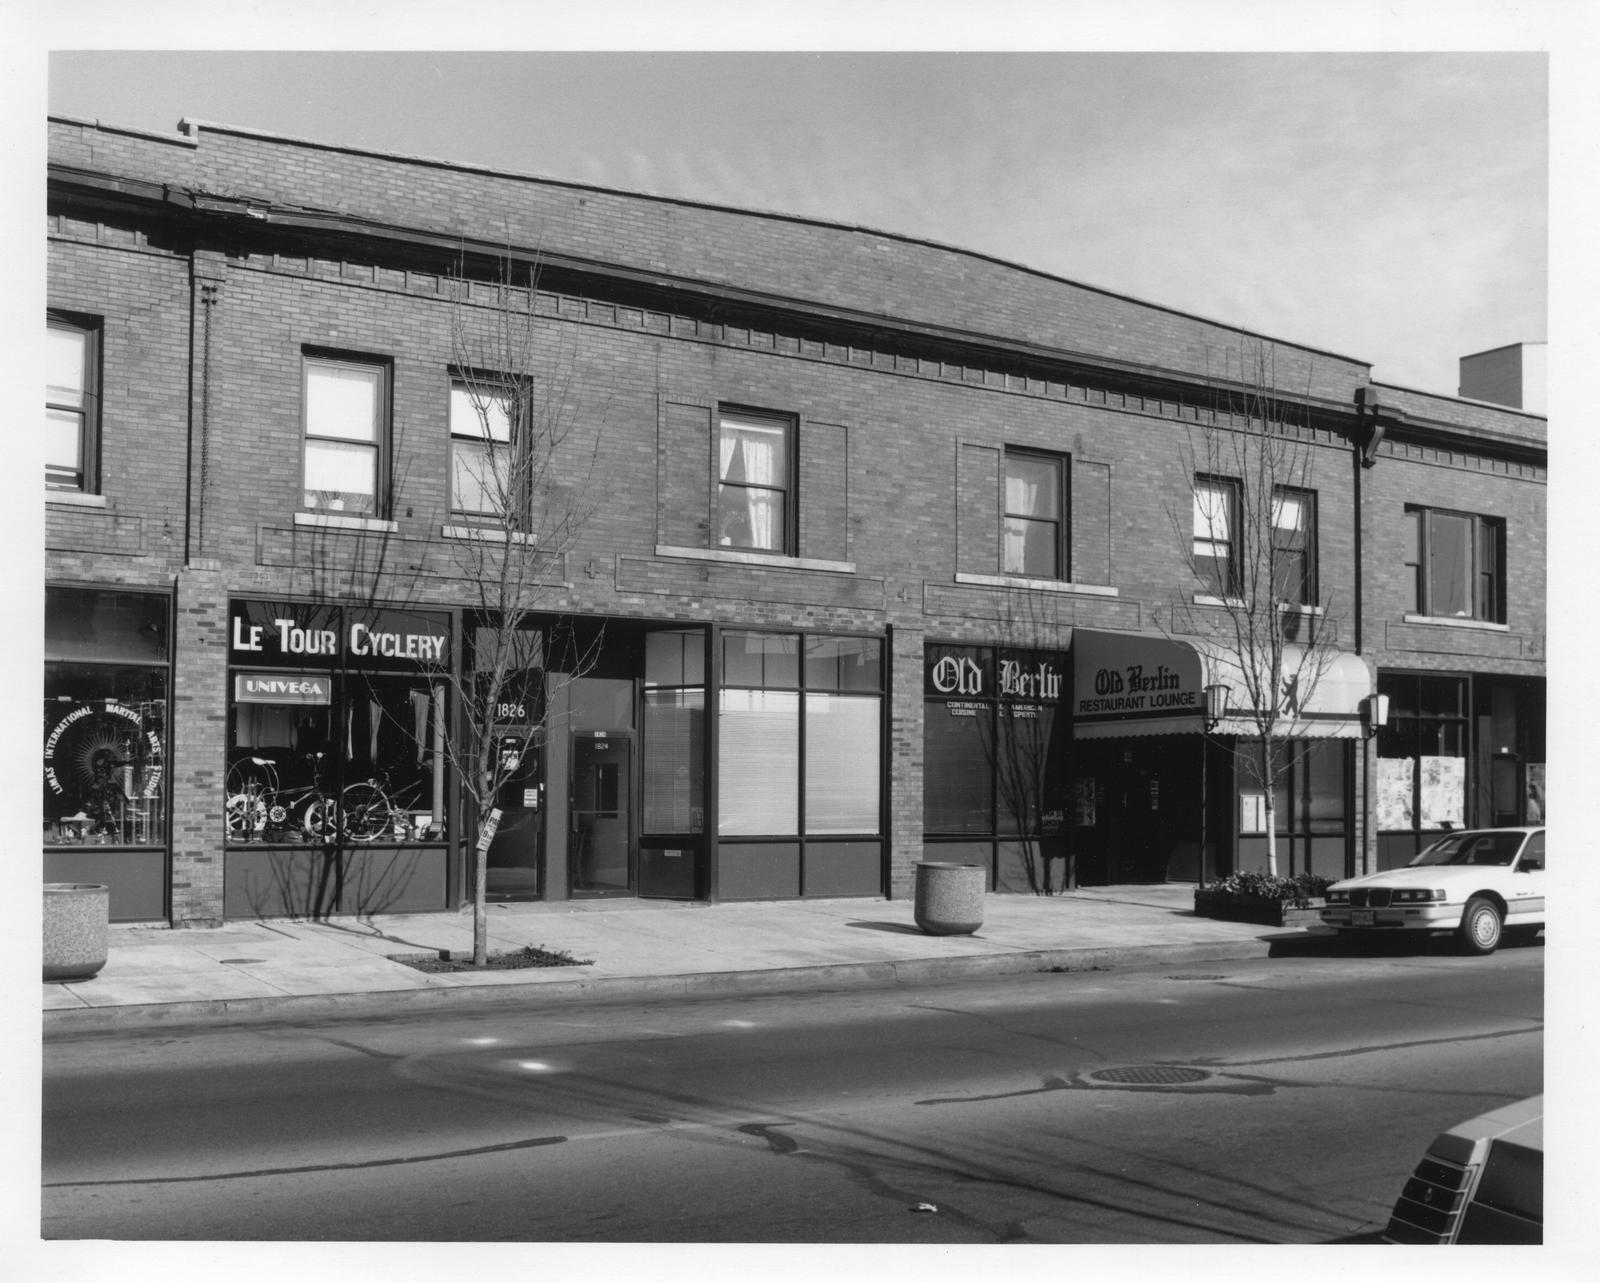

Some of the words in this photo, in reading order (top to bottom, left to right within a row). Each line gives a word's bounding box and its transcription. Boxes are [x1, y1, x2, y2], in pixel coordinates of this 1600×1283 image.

[932, 655, 983, 695] Old
[1094, 667, 1123, 696] Old
[1127, 663, 1181, 696] Berlin
[246, 680, 323, 696] UNIVEGA
[497, 703, 526, 718] 1826
[946, 701, 989, 710] CONTINENTAL
[951, 709, 977, 717] CUISINE
[1079, 695, 1146, 713] RESTAURANT
[1149, 691, 1196, 707] LOUNGE
[105, 703, 142, 725] MARTIAL
[45, 705, 94, 759] INTERNATIONAL
[147, 730, 162, 754] ARTS
[45, 766, 63, 795] LIMAS
[144, 765, 163, 797] STUDIO
